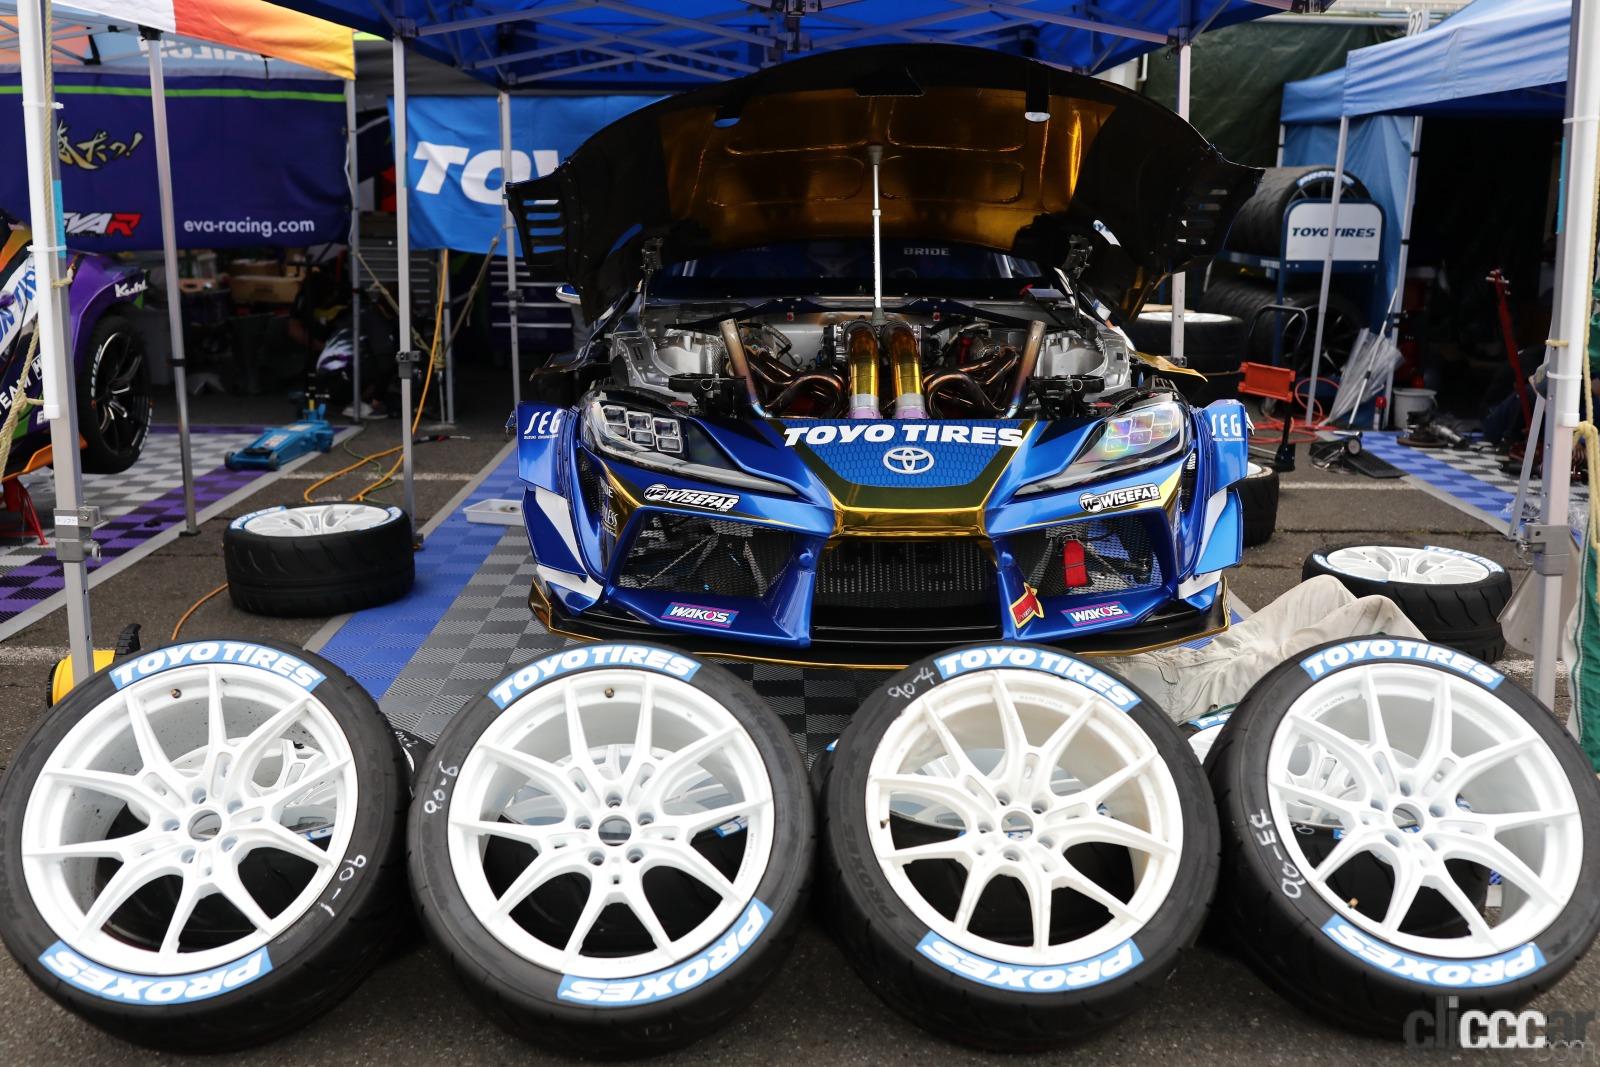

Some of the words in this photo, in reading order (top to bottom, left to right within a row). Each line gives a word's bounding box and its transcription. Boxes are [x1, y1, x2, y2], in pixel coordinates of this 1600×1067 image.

[184, 216, 315, 238] eva-racing.com
[903, 247, 951, 256] BRIDE
[523, 408, 562, 435] SEG
[784, 424, 895, 447] TOYO
[901, 424, 1024, 447] TIRES
[1211, 413, 1242, 437] SEG
[664, 489, 740, 510] WISEFAB
[1100, 485, 1160, 509] WISEFAB
[113, 642, 219, 685] TOYO
[222, 643, 320, 687] TIRES
[494, 649, 589, 704] TOYO
[591, 645, 697, 677] TIRES
[938, 647, 1038, 676] TOYO
[1040, 652, 1138, 707] TIRES
[1306, 639, 1395, 676] TOYO
[1397, 641, 1500, 684] TIRES
[560, 903, 765, 1001] PROXES
[921, 940, 1133, 990] PROXES
[1327, 924, 1537, 985] PROXES
[44, 950, 263, 1002] PROXES
